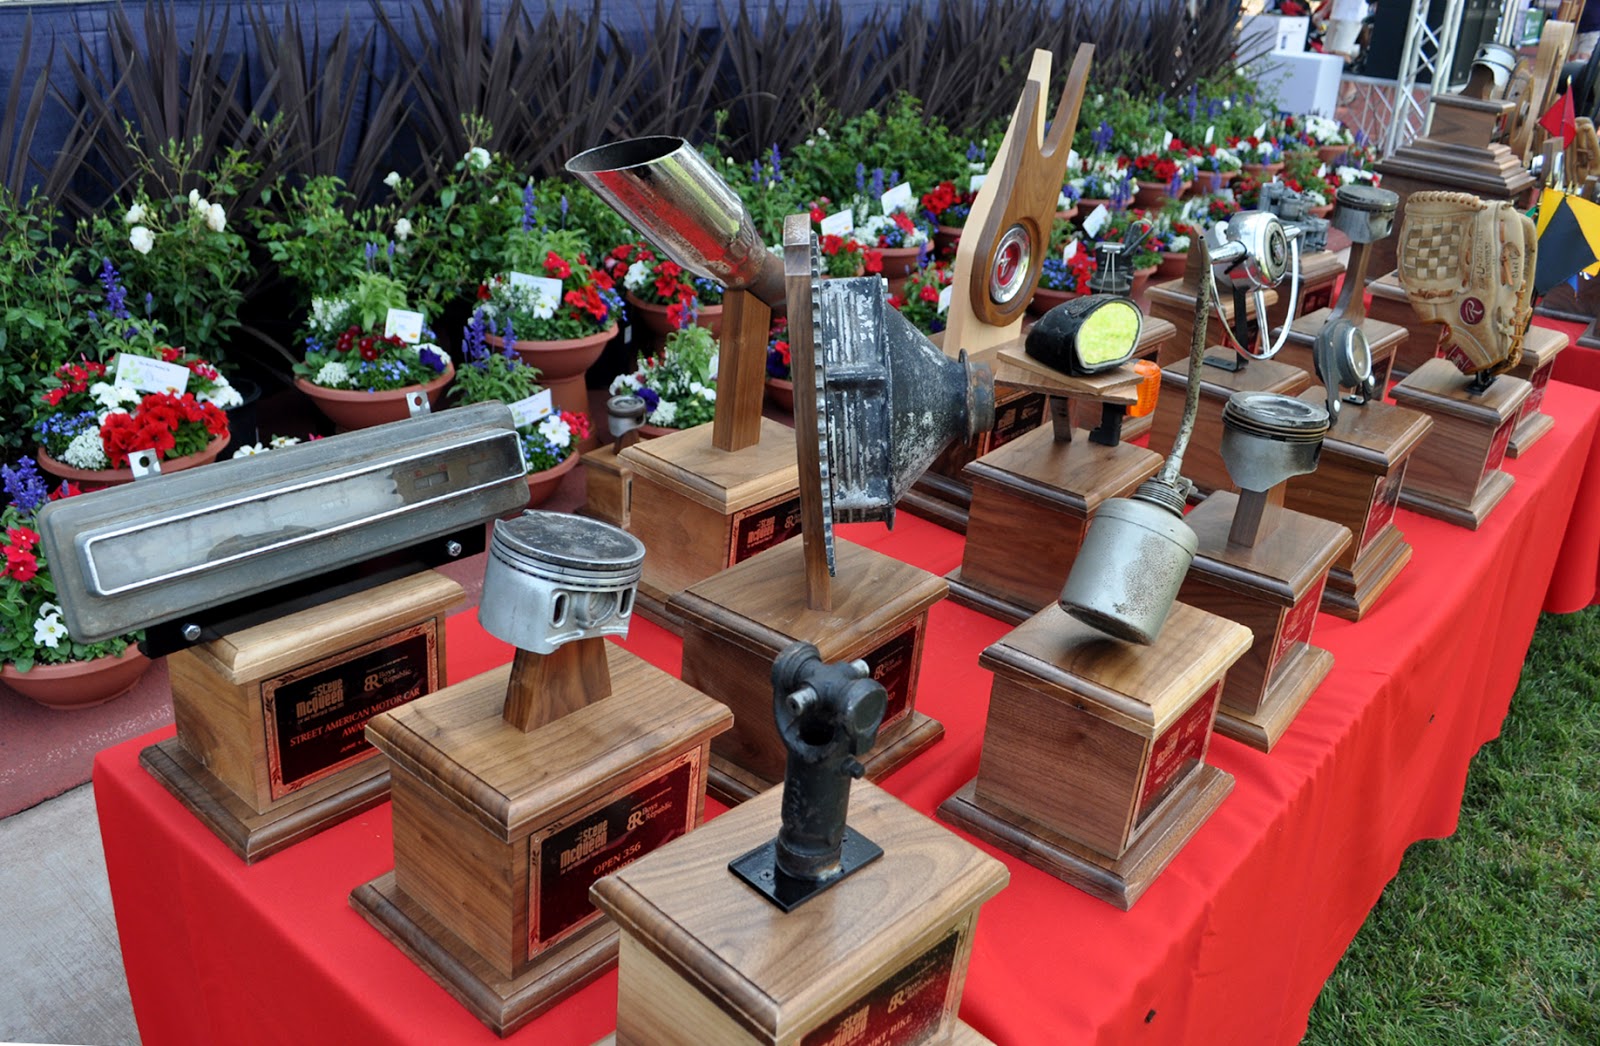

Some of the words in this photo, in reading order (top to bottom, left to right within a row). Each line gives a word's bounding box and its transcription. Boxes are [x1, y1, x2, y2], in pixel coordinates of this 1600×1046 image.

[290, 726, 323, 747] STREET
[324, 708, 370, 732] AMERICAN
[371, 694, 403, 714] MOTOR
[403, 687, 420, 700] CAR
[342, 720, 370, 737] AWAR
[593, 853, 621, 876] OPEN
[622, 841, 641, 859] 356
